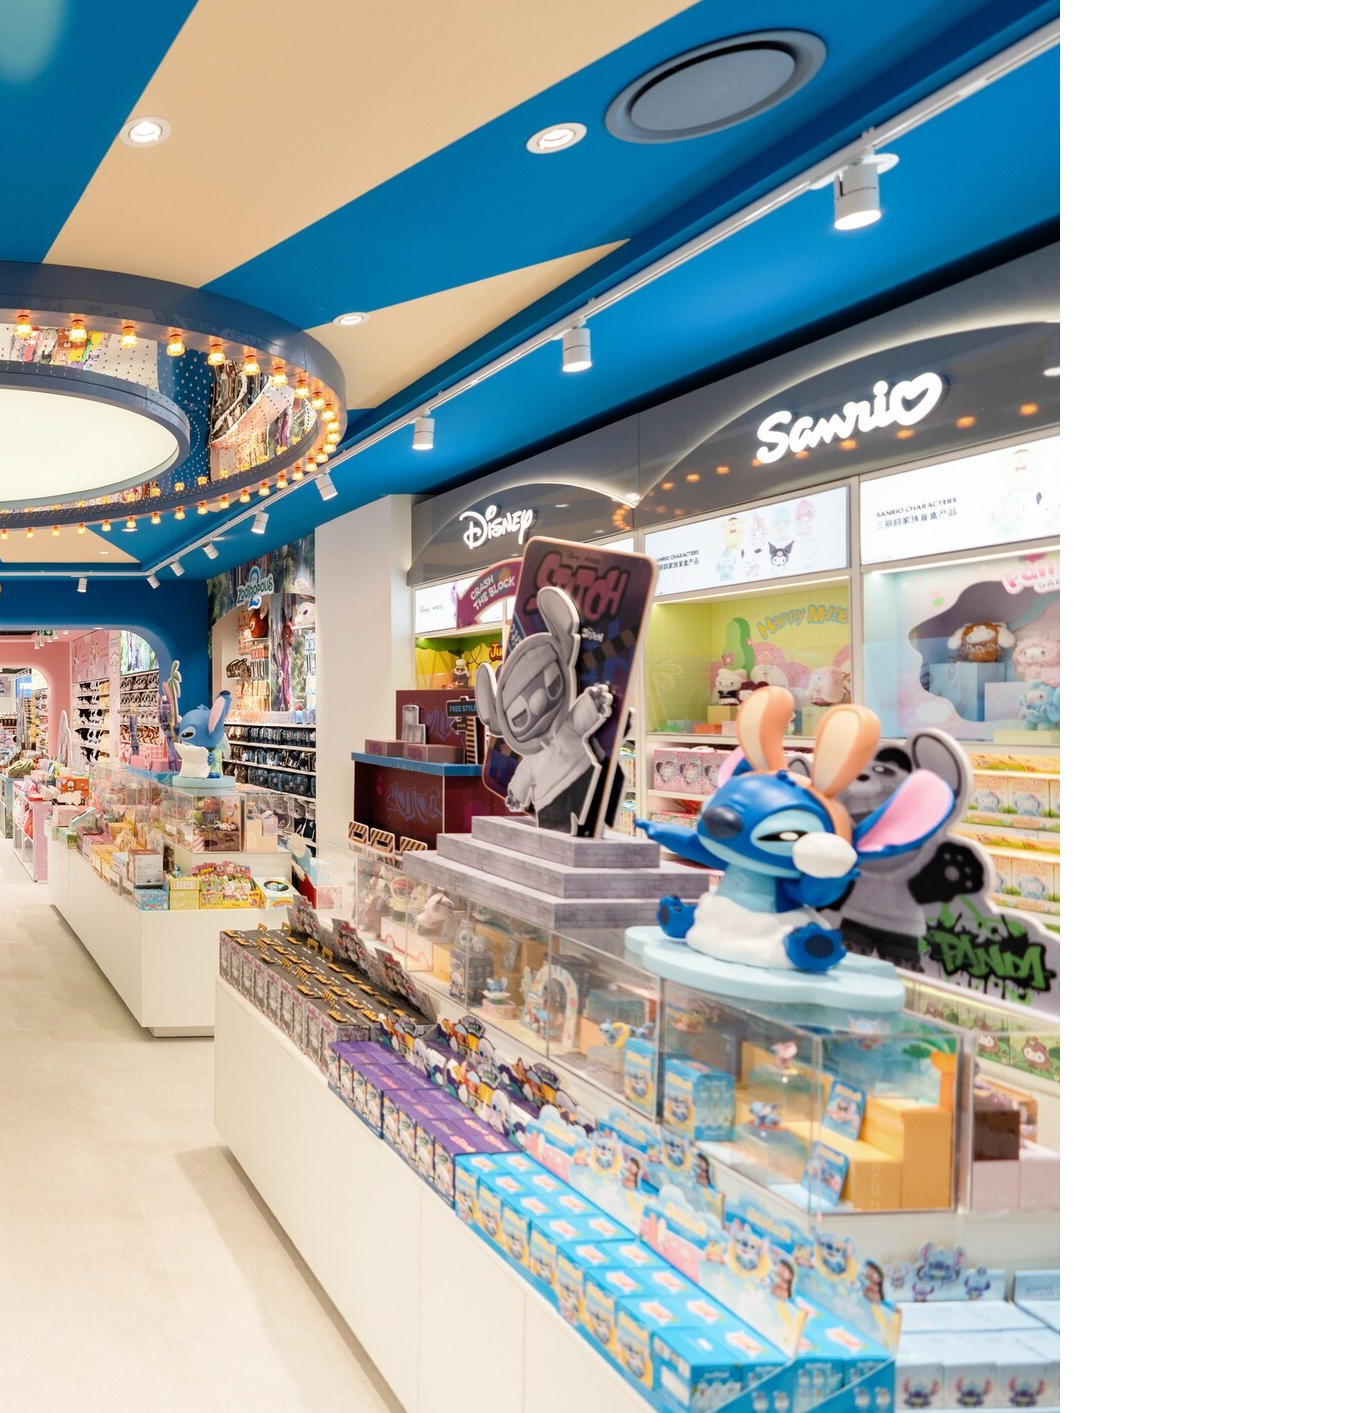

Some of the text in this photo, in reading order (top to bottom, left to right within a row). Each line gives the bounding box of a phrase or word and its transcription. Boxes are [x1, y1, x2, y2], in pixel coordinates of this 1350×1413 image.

[755, 371, 943, 464] Sanrio
[876, 497, 957, 518] SANRIO CHARACTERS
[470, 574, 494, 600] CRASH
[472, 576, 516, 610] THE BLOCK
[449, 705, 461, 713] FREE
[929, 928, 1047, 990] PANDA
